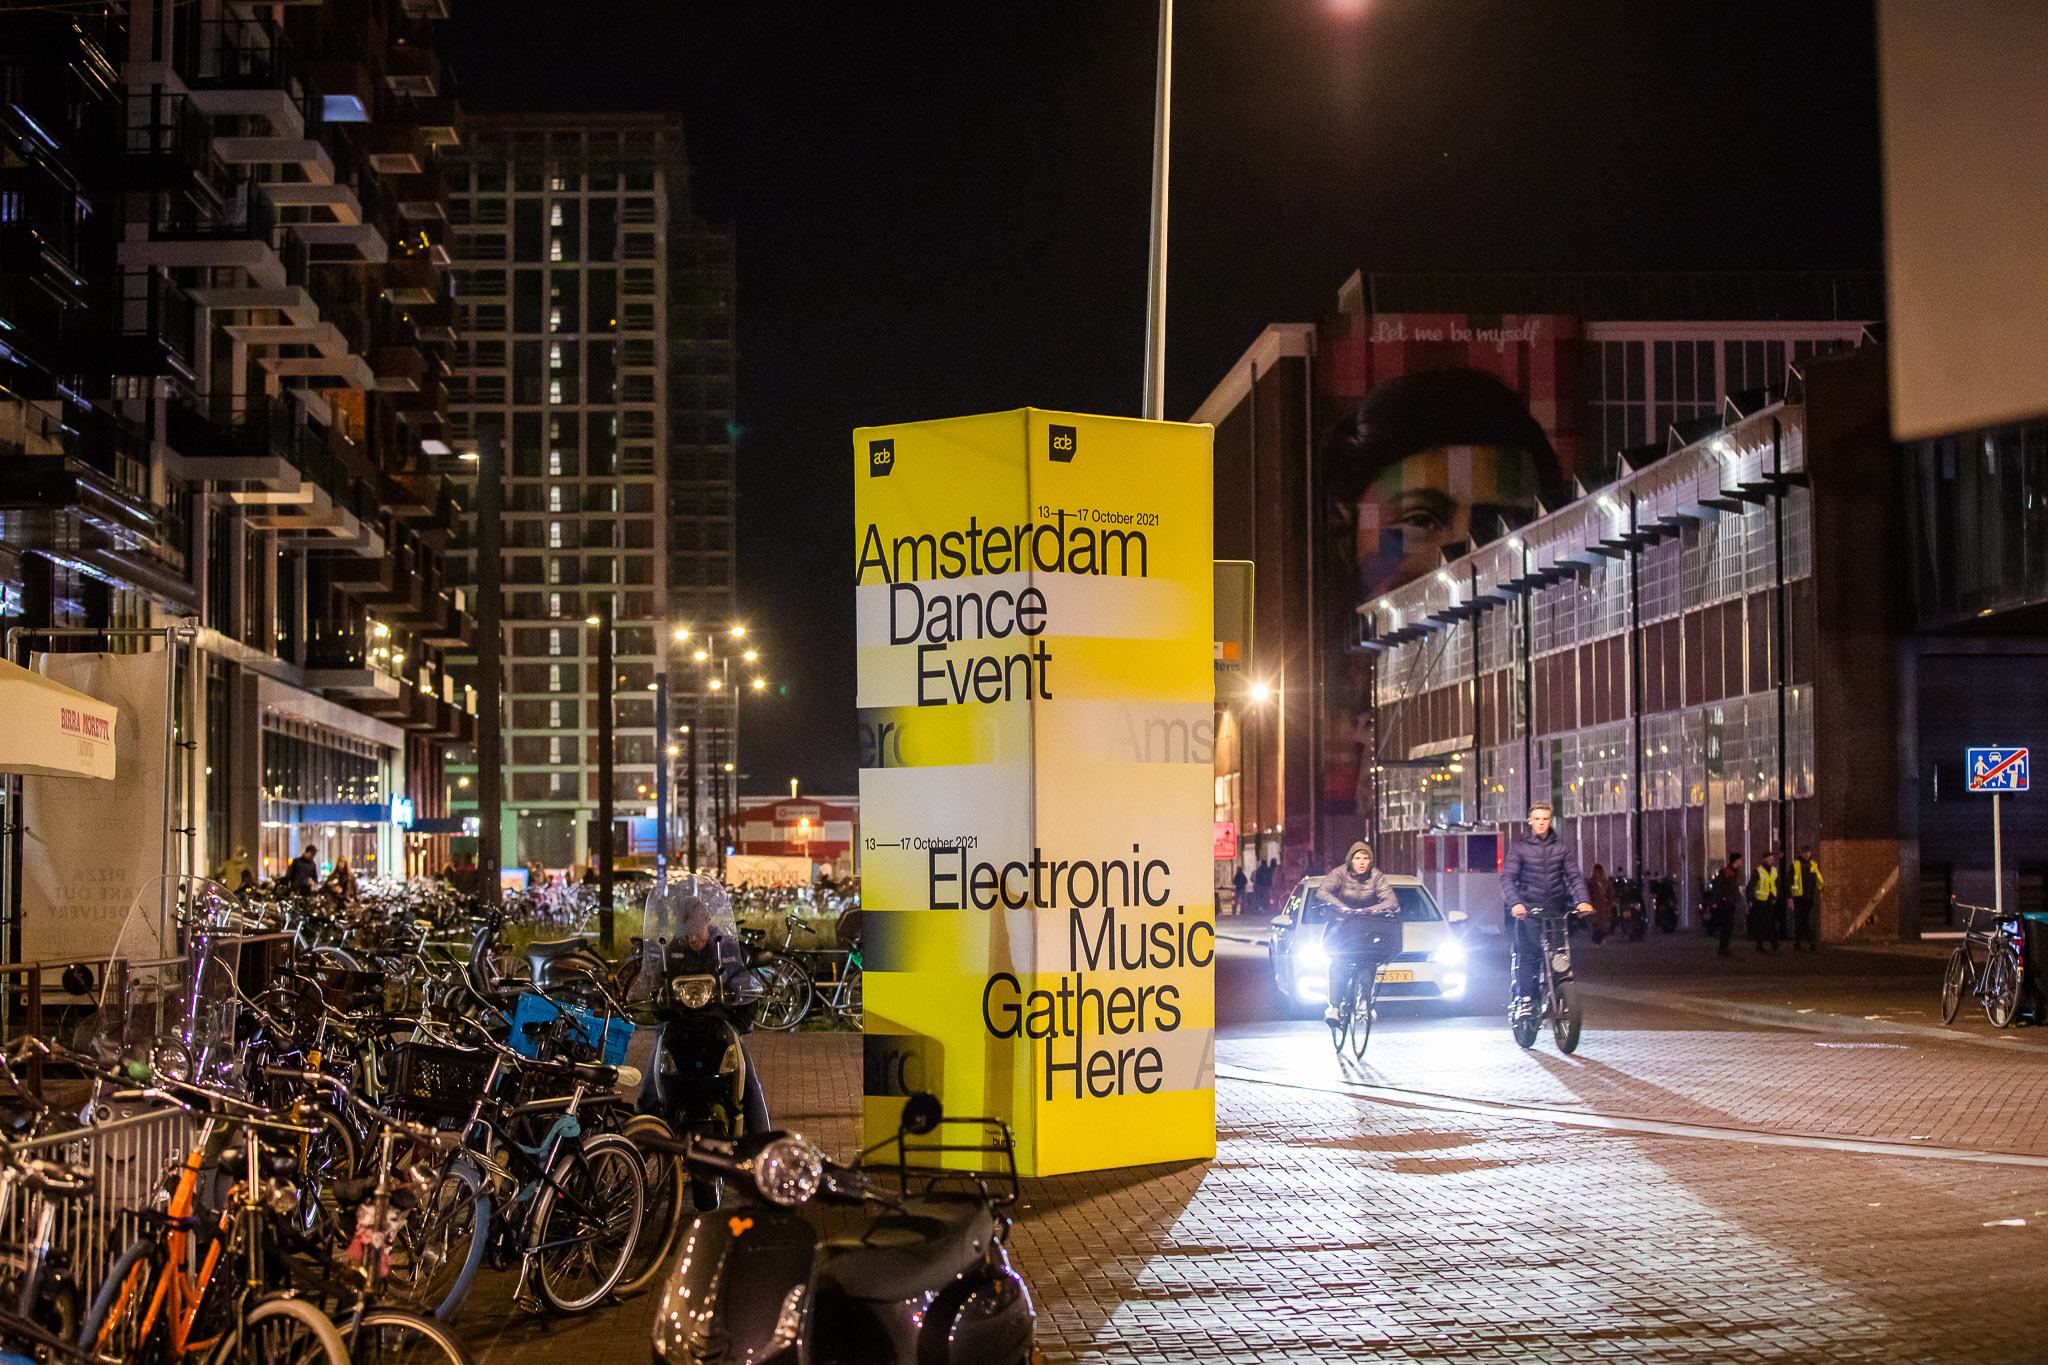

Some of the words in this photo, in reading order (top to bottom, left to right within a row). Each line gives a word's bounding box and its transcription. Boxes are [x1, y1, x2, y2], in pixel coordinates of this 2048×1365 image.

[1369, 321, 1408, 343] Let
[1415, 328, 1443, 342] me
[1450, 320, 1473, 343] be
[1477, 319, 1540, 353] myself
[856, 509, 1147, 586] Amsterdam
[1091, 510, 1134, 525] October
[1136, 512, 1159, 526] 2021
[890, 583, 1047, 645] Dance
[917, 639, 1052, 707] Event
[60, 707, 81, 733] BIRRA
[82, 713, 110, 741] MORETTI
[913, 836, 954, 851] October
[956, 835, 978, 850] 2021
[929, 843, 1170, 910] Electronic
[1070, 906, 1214, 971] Music
[983, 972, 1181, 1039] Gathers
[1046, 1034, 1163, 1101] Here
